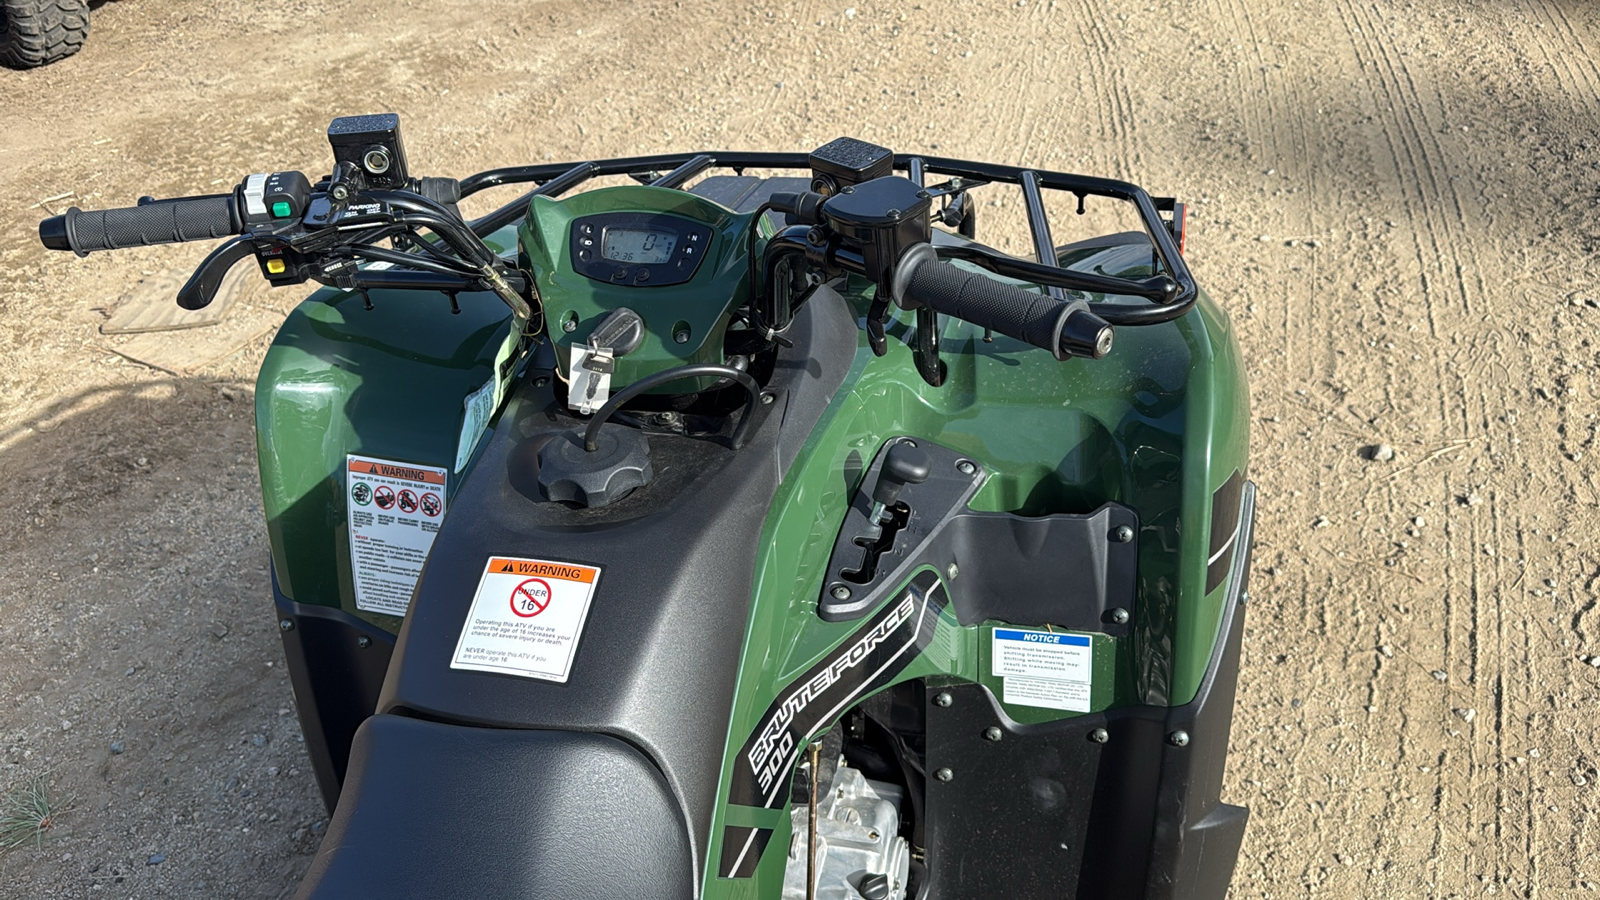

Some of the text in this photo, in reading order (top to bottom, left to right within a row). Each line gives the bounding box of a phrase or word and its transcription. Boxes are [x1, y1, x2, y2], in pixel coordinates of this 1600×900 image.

[381, 466, 425, 480] WARNING
[518, 563, 581, 578] WARNING
[517, 588, 547, 598] UNDER
[520, 600, 535, 611] 16
[475, 619, 502, 627] Operating
[528, 631, 555, 639] increases
[1024, 634, 1060, 643] NOTICE
[758, 731, 793, 795] 300
